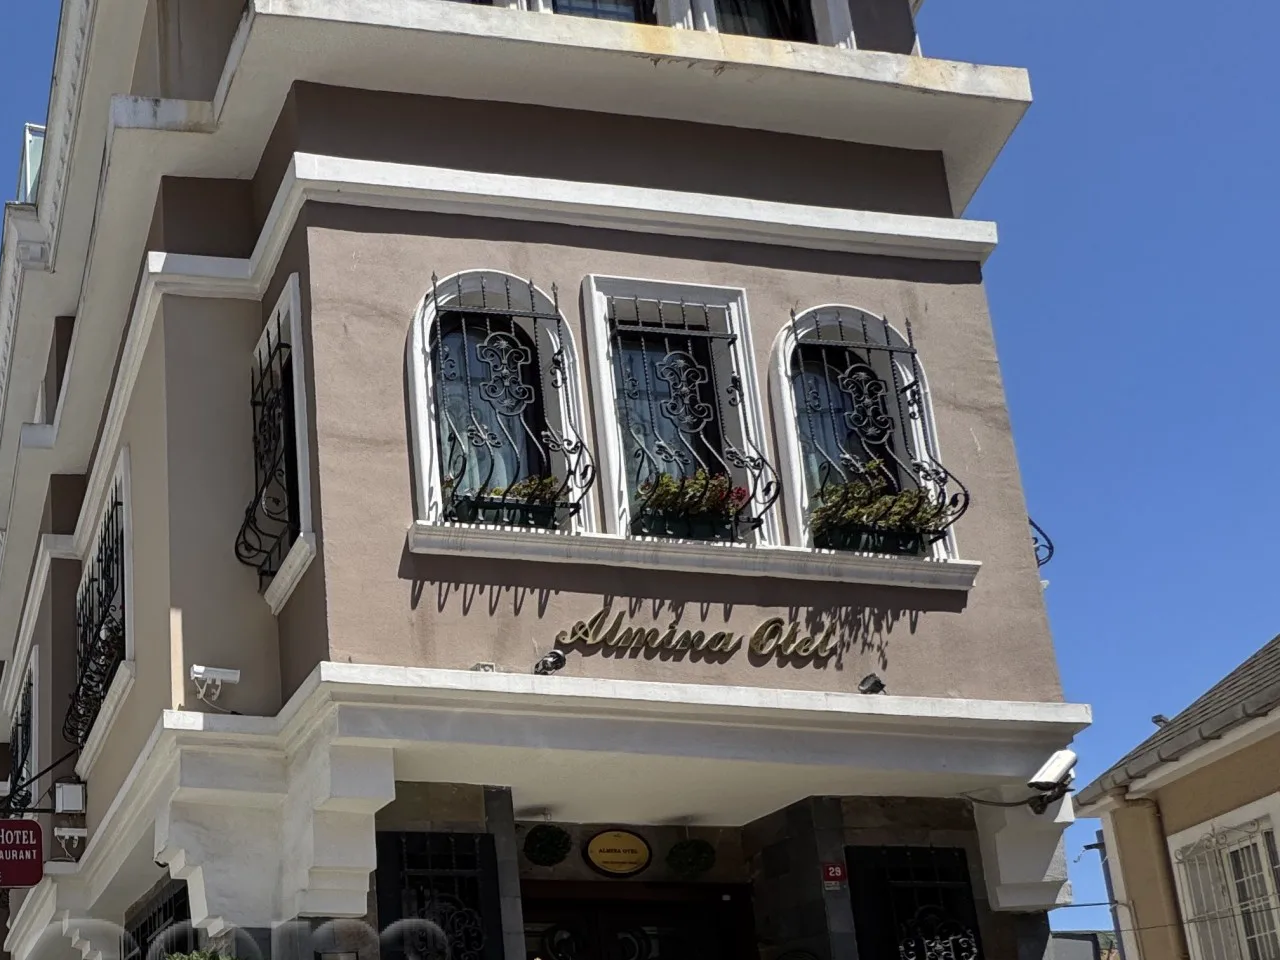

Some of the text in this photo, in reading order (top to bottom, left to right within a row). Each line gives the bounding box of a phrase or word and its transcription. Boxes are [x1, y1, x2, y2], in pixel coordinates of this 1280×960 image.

[556, 605, 841, 659] Almina Otel
[828, 866, 842, 877] 29
